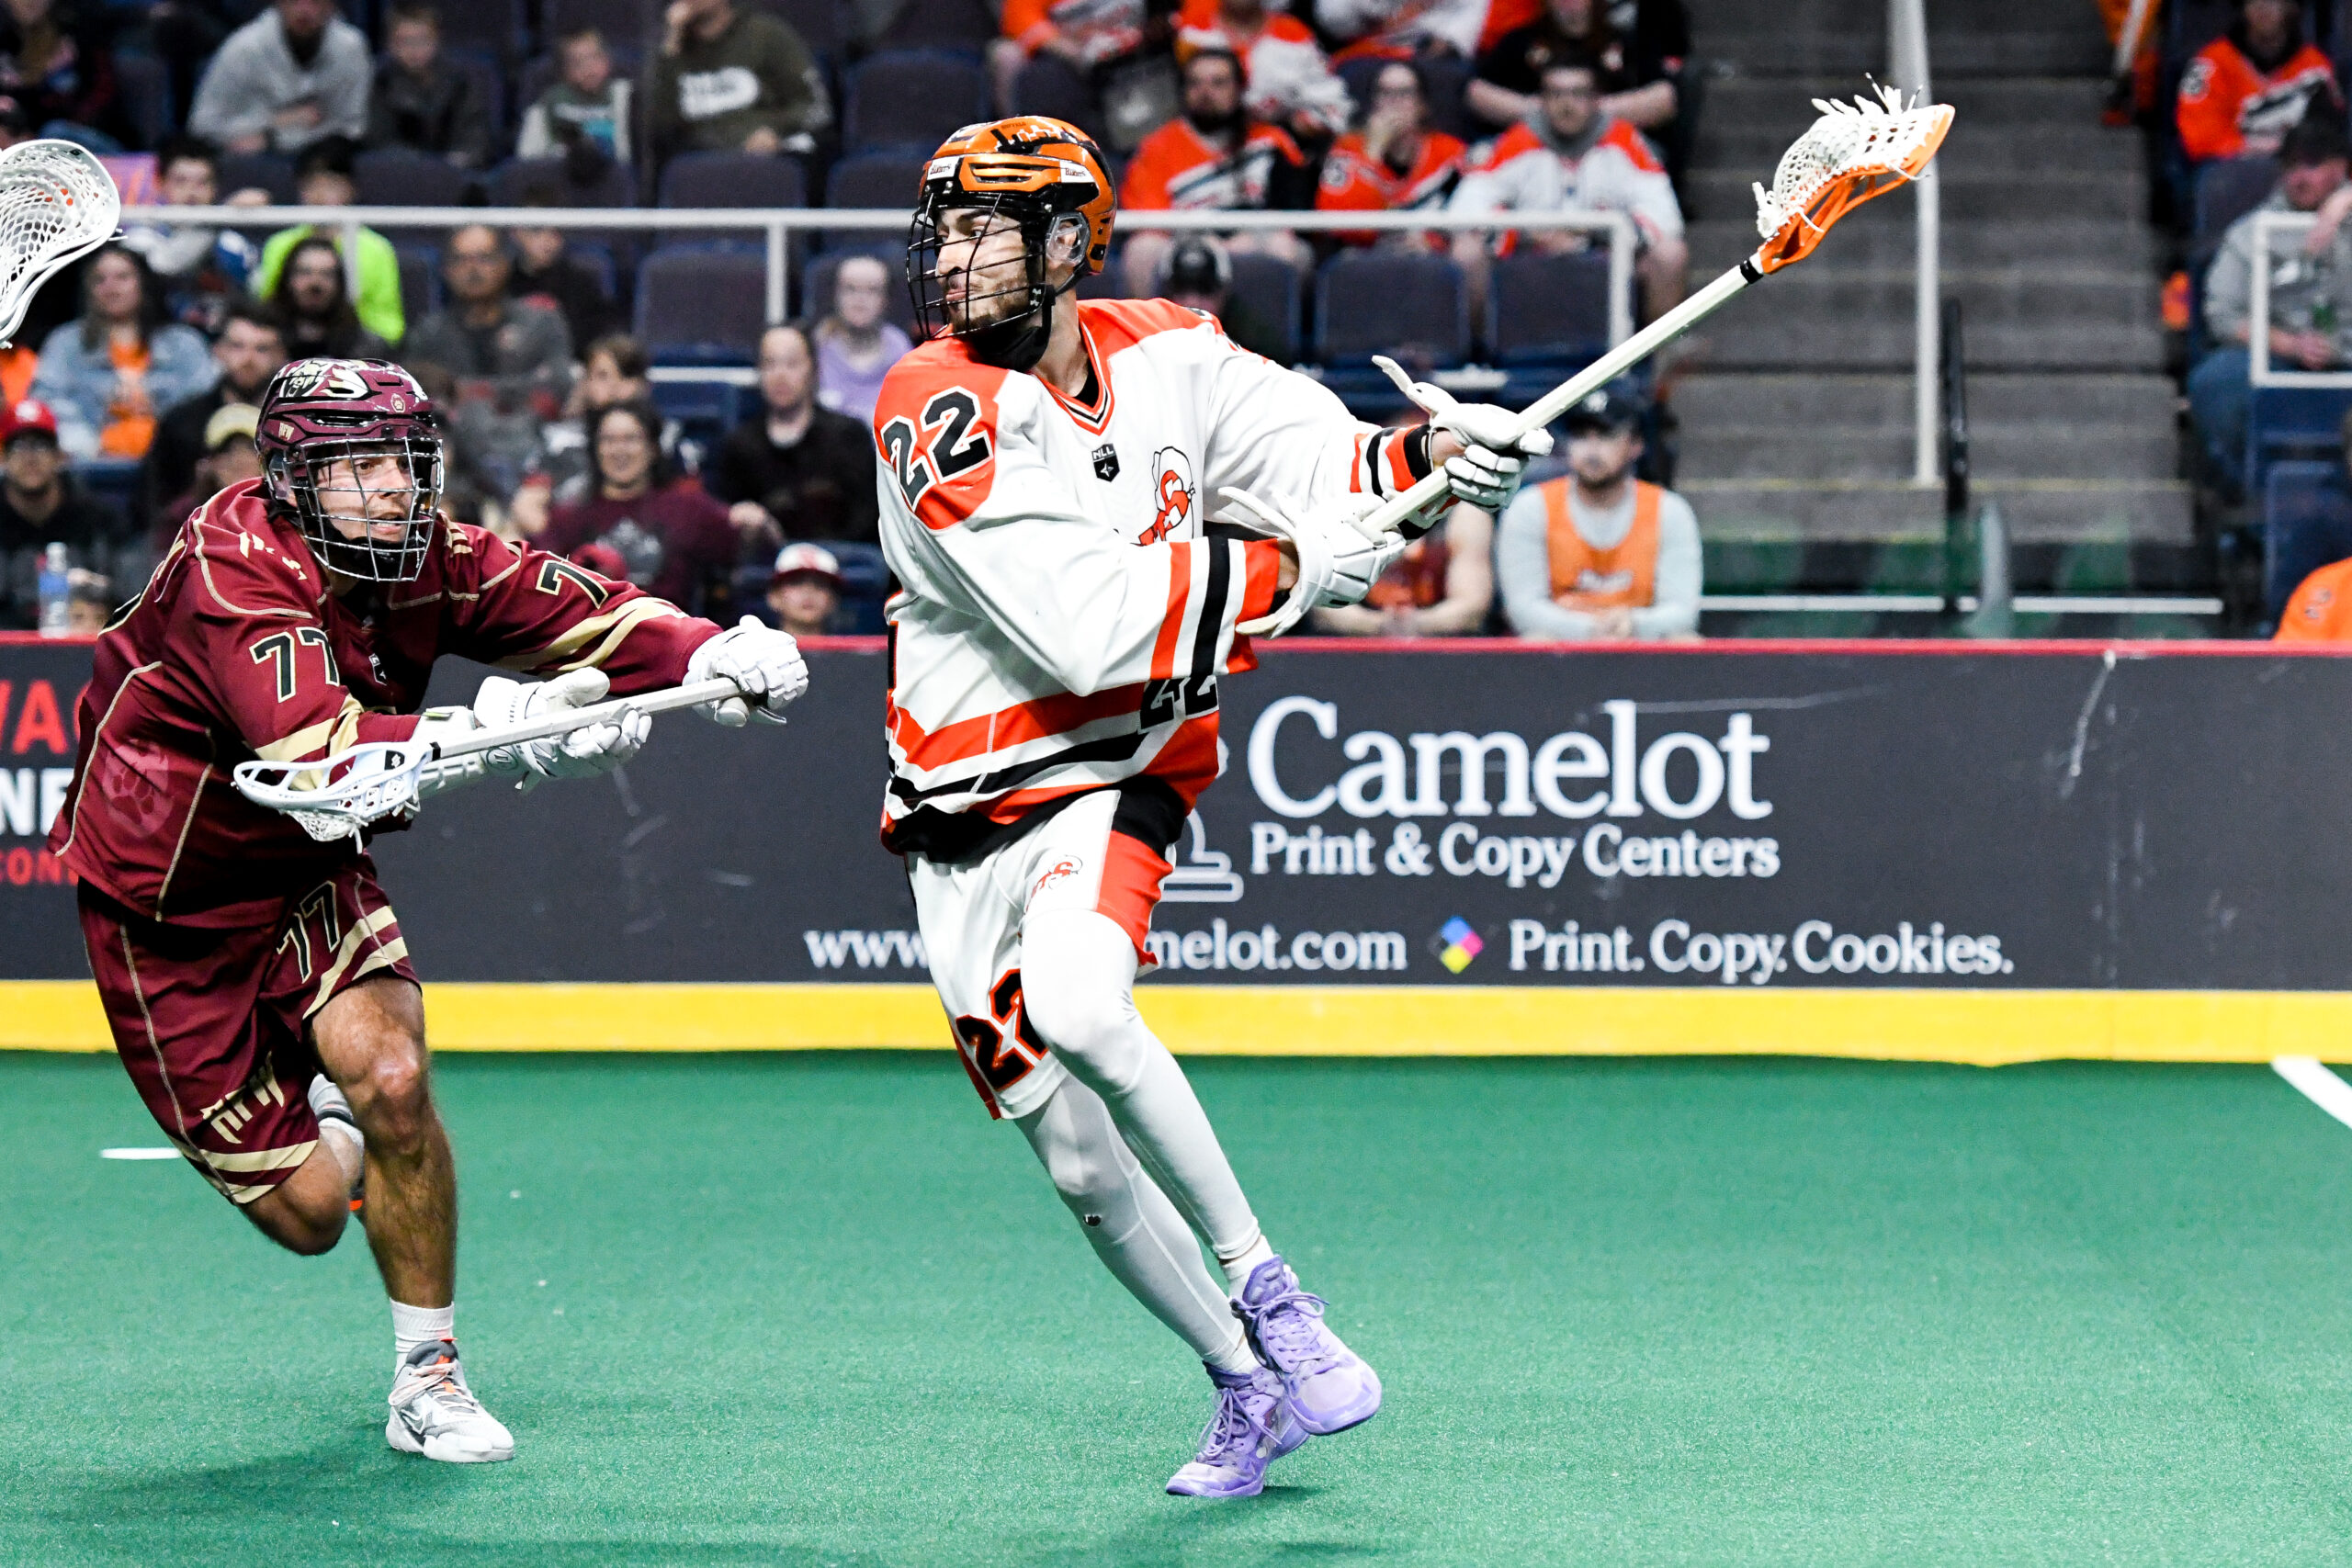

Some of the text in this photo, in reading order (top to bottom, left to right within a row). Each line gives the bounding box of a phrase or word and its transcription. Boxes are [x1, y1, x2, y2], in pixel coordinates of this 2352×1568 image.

[880, 386, 993, 514] 22
[1092, 446, 1114, 460] NLL
[536, 551, 609, 610] 7
[249, 626, 340, 704] 77
[1247, 695, 1774, 819] Camelot
[1250, 821, 1781, 888] Print & Copy Centers
[276, 880, 341, 985] 77
[1509, 919, 2015, 985] Print. Copy. Cookies.
